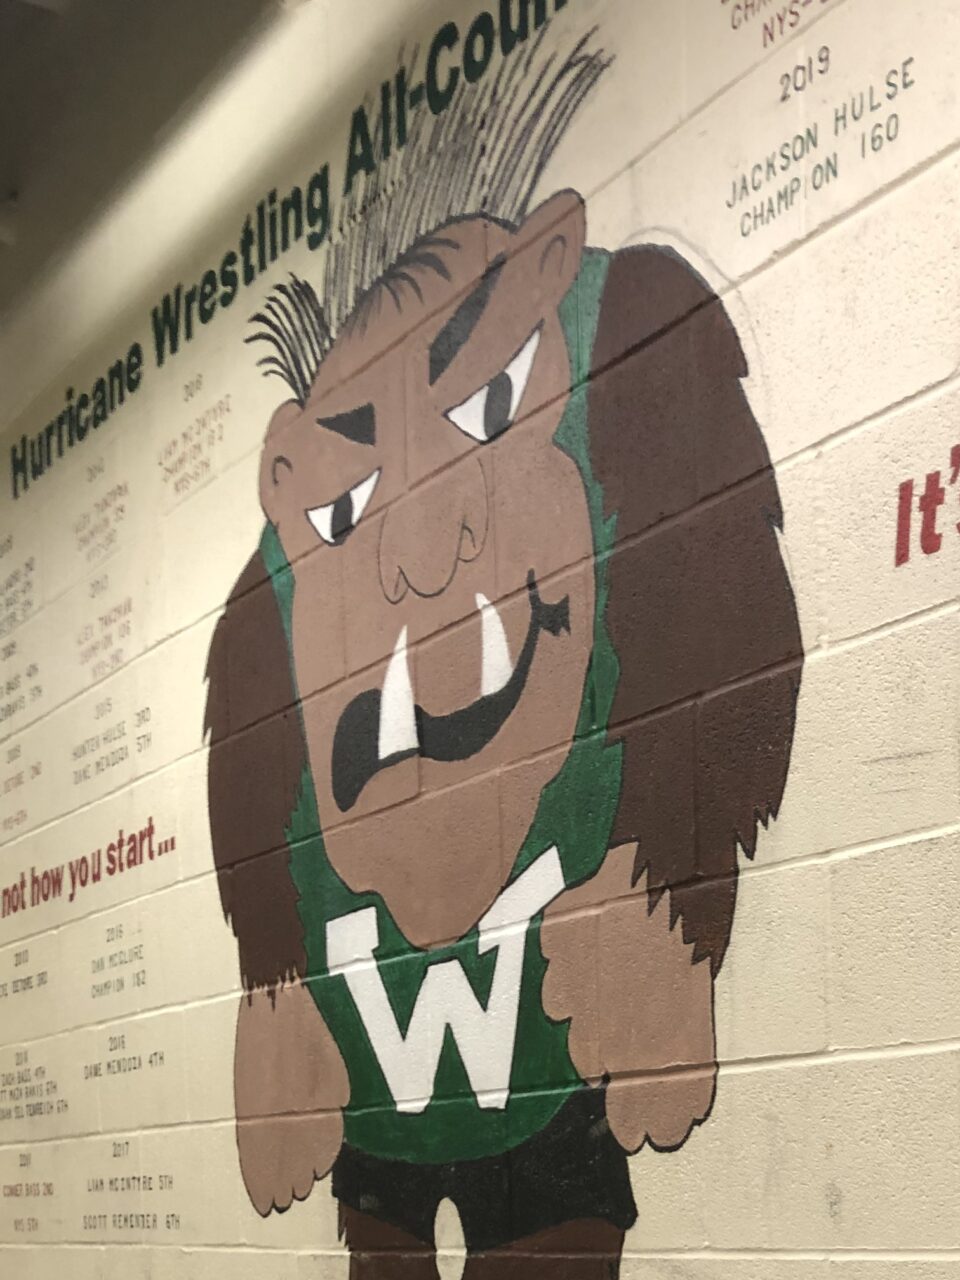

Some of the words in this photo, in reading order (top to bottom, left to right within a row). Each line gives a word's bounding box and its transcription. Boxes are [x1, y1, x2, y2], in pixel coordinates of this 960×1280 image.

[779, 45, 830, 102] 2019
[725, 122, 819, 209] JACKSON
[833, 57, 915, 137] HULSE
[861, 113, 899, 159] 160
[11, 342, 142, 499] Hurricane
[151, 163, 329, 367] Wrestling
[1, 872, 27, 918] not
[30, 866, 65, 907] how
[68, 849, 102, 902] you
[106, 816, 176, 876] start...
[325, 845, 566, 1113] W
[106, 1056, 142, 1075] MENDOZA
[148, 1050, 165, 1068] 4TH
[112, 1141, 129, 1158] 2017
[158, 1174, 173, 1191] 5TH
[83, 1214, 107, 1230] SCOTT
[166, 1213, 180, 1230] 6TH
